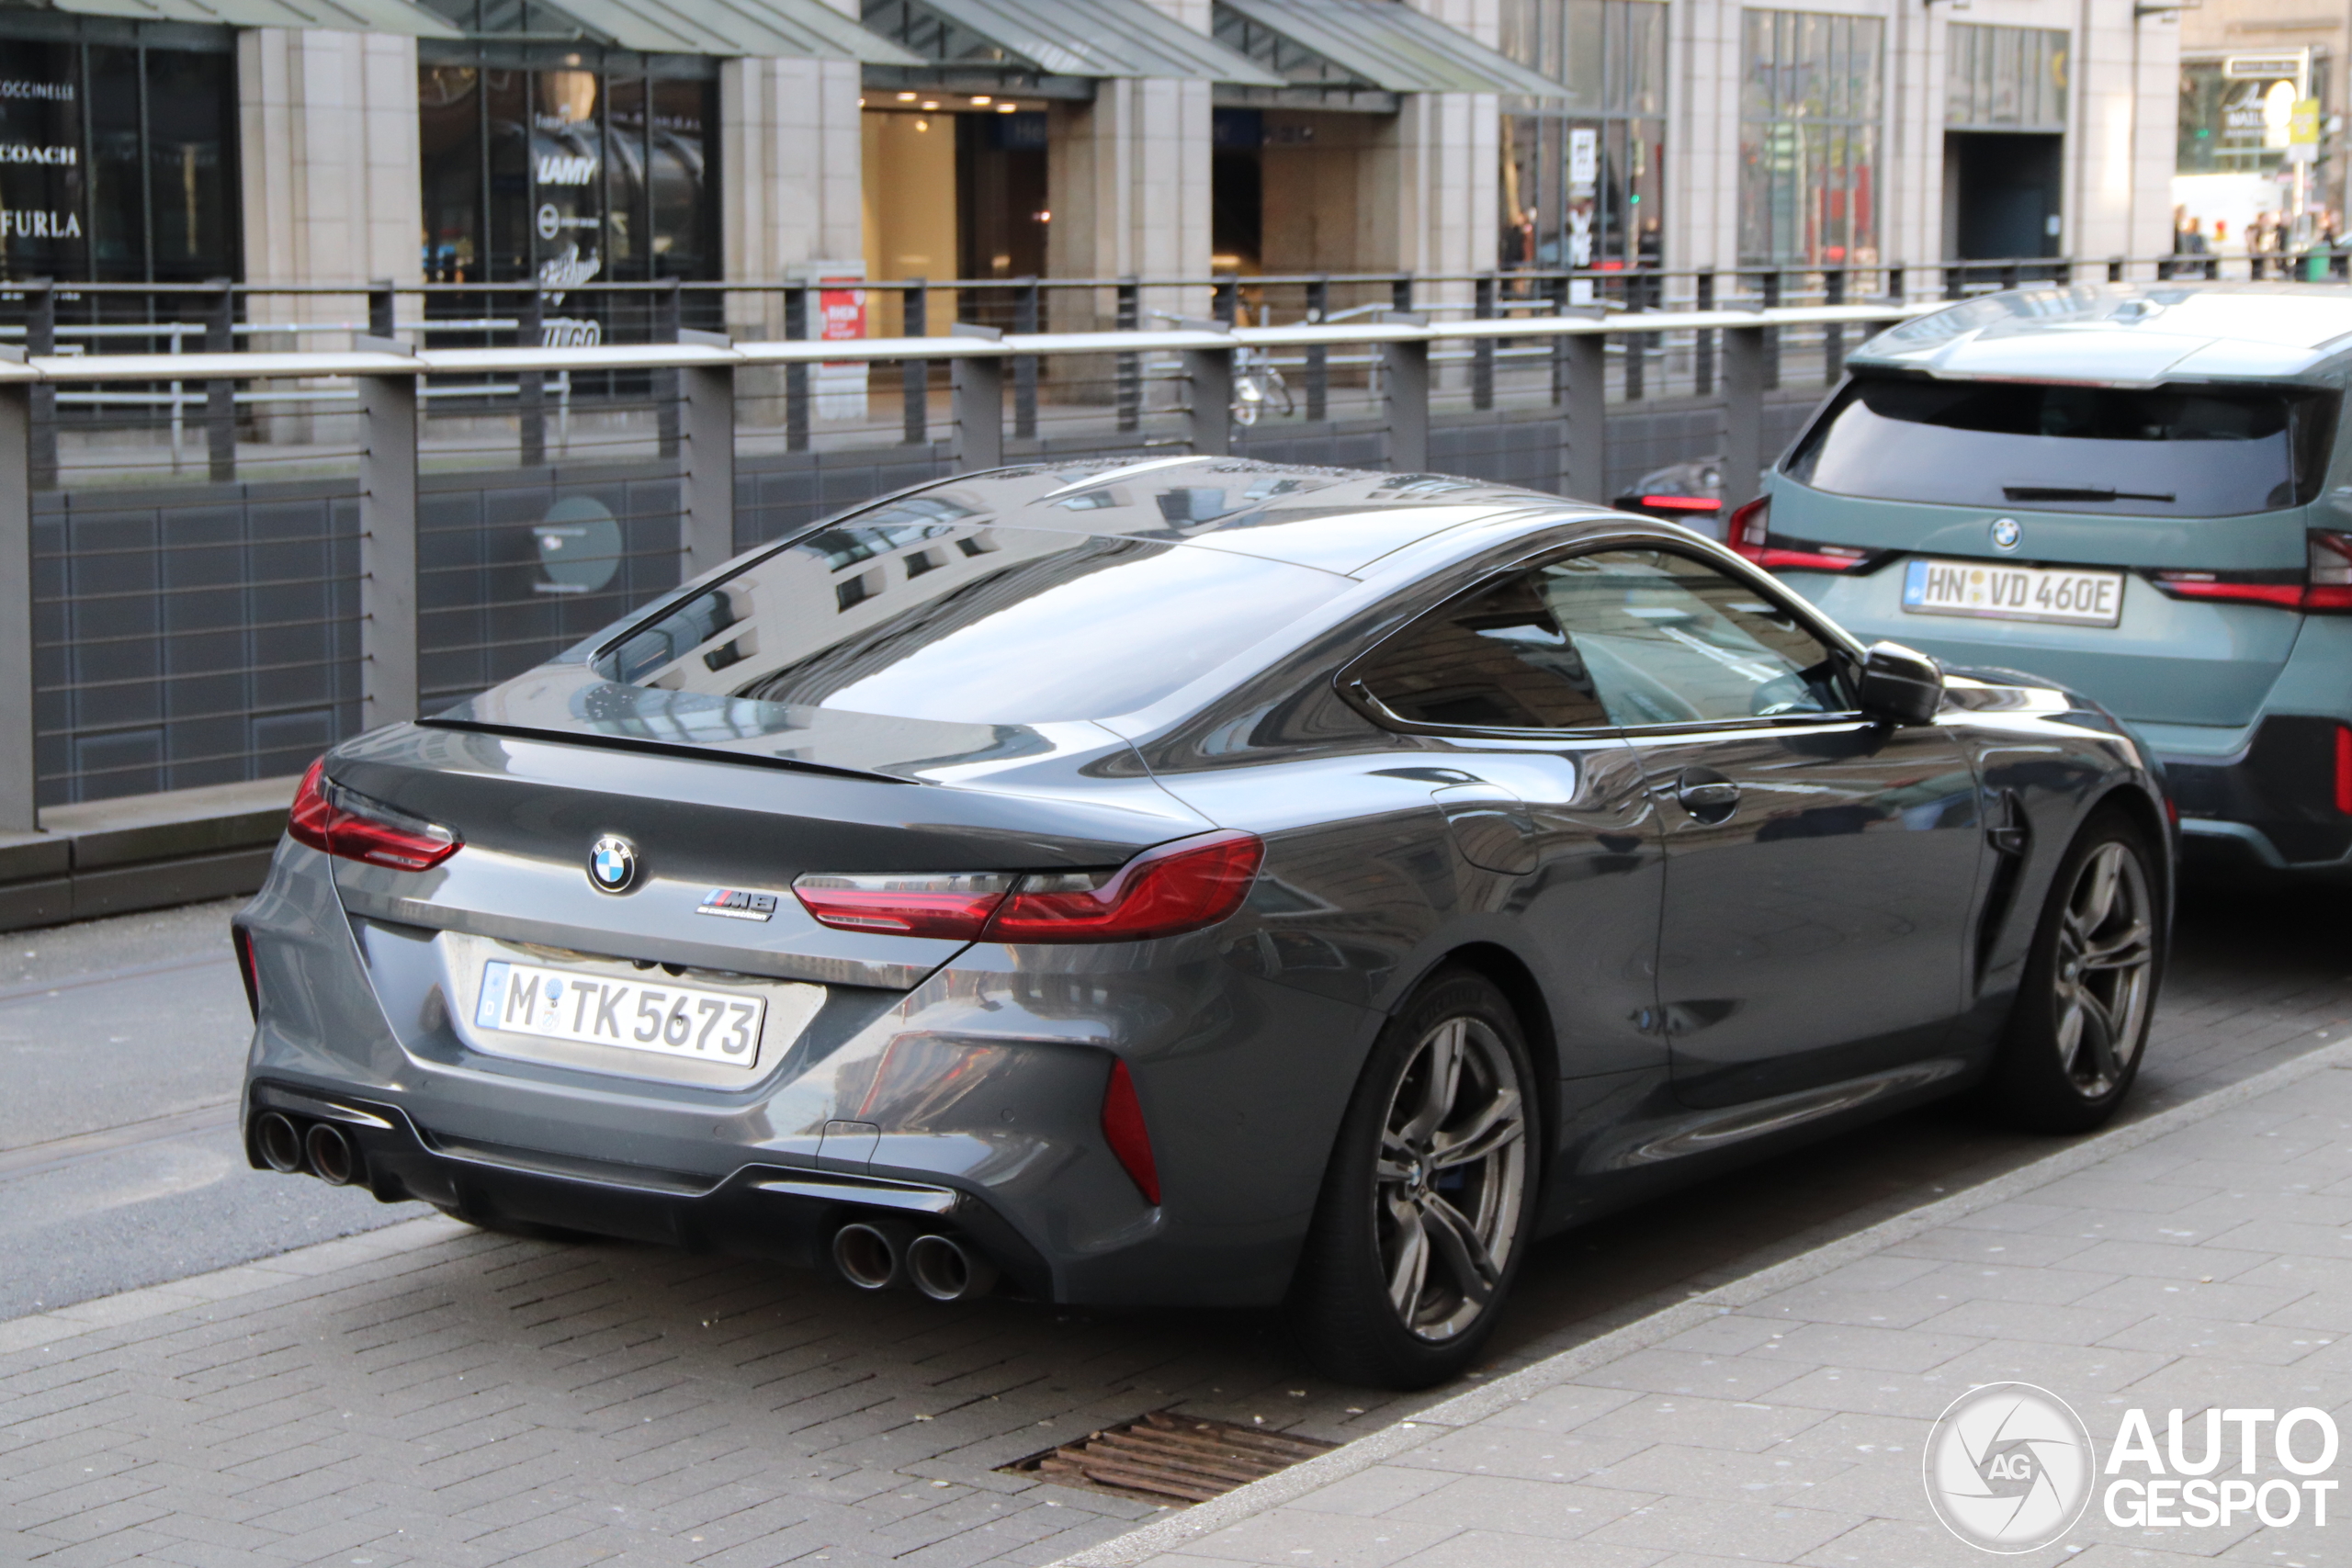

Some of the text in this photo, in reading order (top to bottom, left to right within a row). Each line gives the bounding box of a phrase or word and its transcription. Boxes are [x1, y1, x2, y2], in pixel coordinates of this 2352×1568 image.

[0, 80, 74, 101] OCCINELLE
[0, 144, 76, 165] COACH
[537, 156, 597, 185] LAMY
[0, 209, 81, 238] FURLA
[1926, 568, 2115, 614] HN VD 460E
[594, 838, 631, 860] BMW
[722, 891, 777, 913] M8
[707, 908, 768, 920] competition
[485, 1001, 494, 1016] D
[506, 973, 755, 1055] M TK 5673
